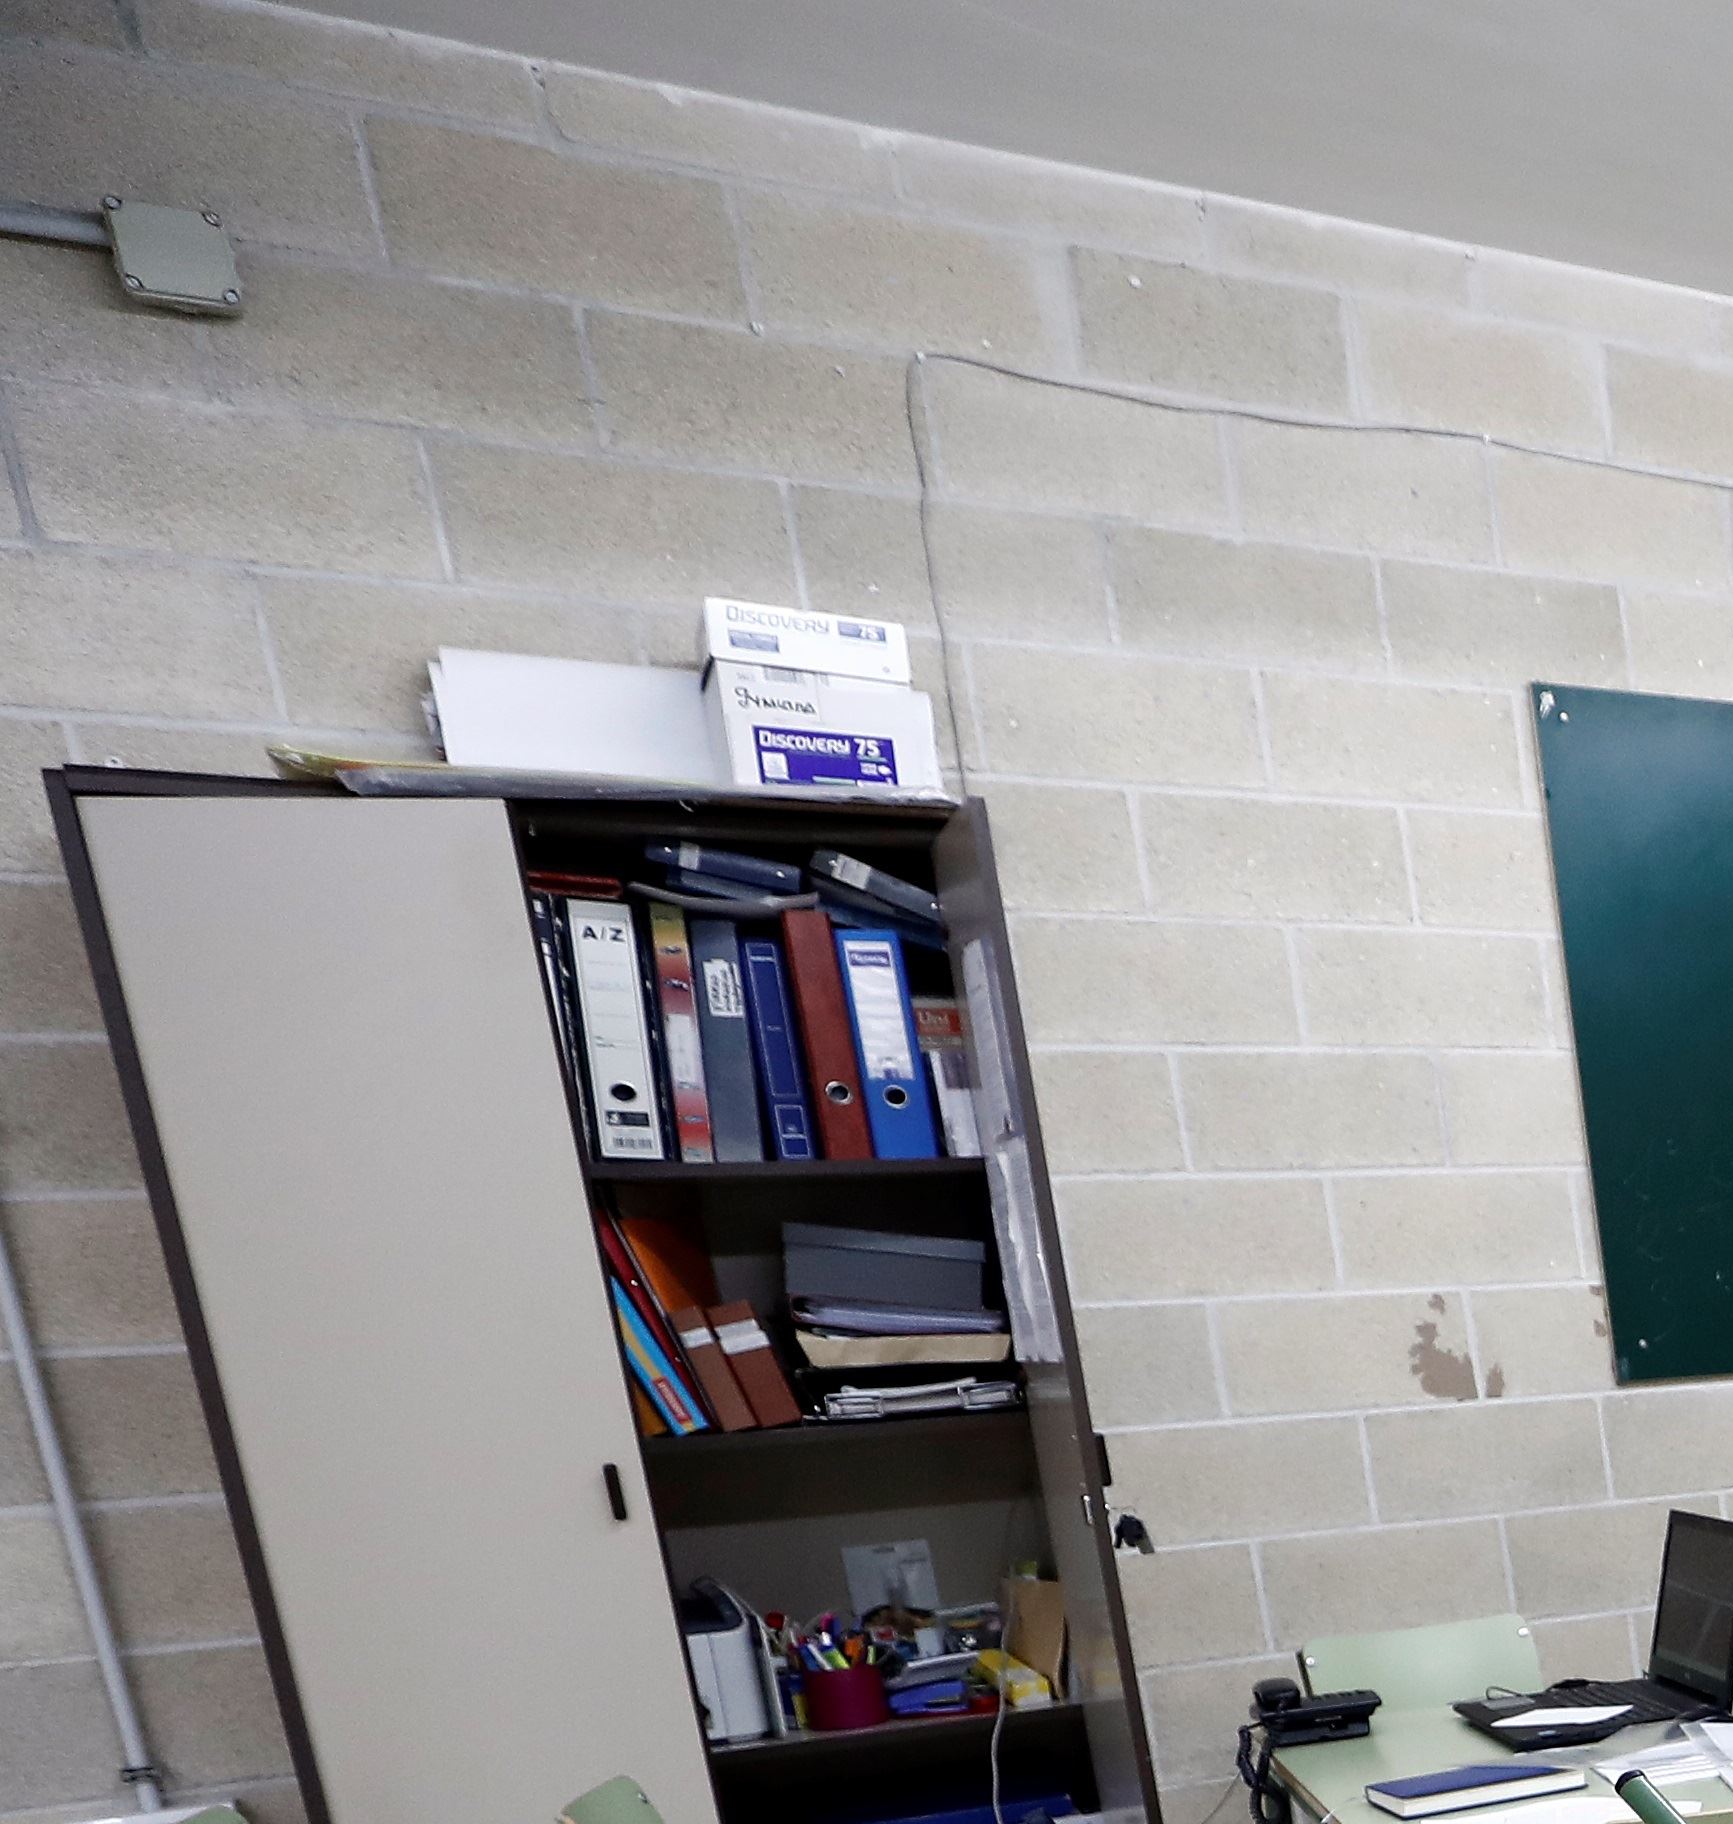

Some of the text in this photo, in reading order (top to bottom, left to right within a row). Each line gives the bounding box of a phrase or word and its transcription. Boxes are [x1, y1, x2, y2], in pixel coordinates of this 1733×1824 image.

[726, 605, 830, 634] DISCOVERY
[758, 730, 881, 757] DISCOVERY 75
[582, 926, 627, 943] A/Z
